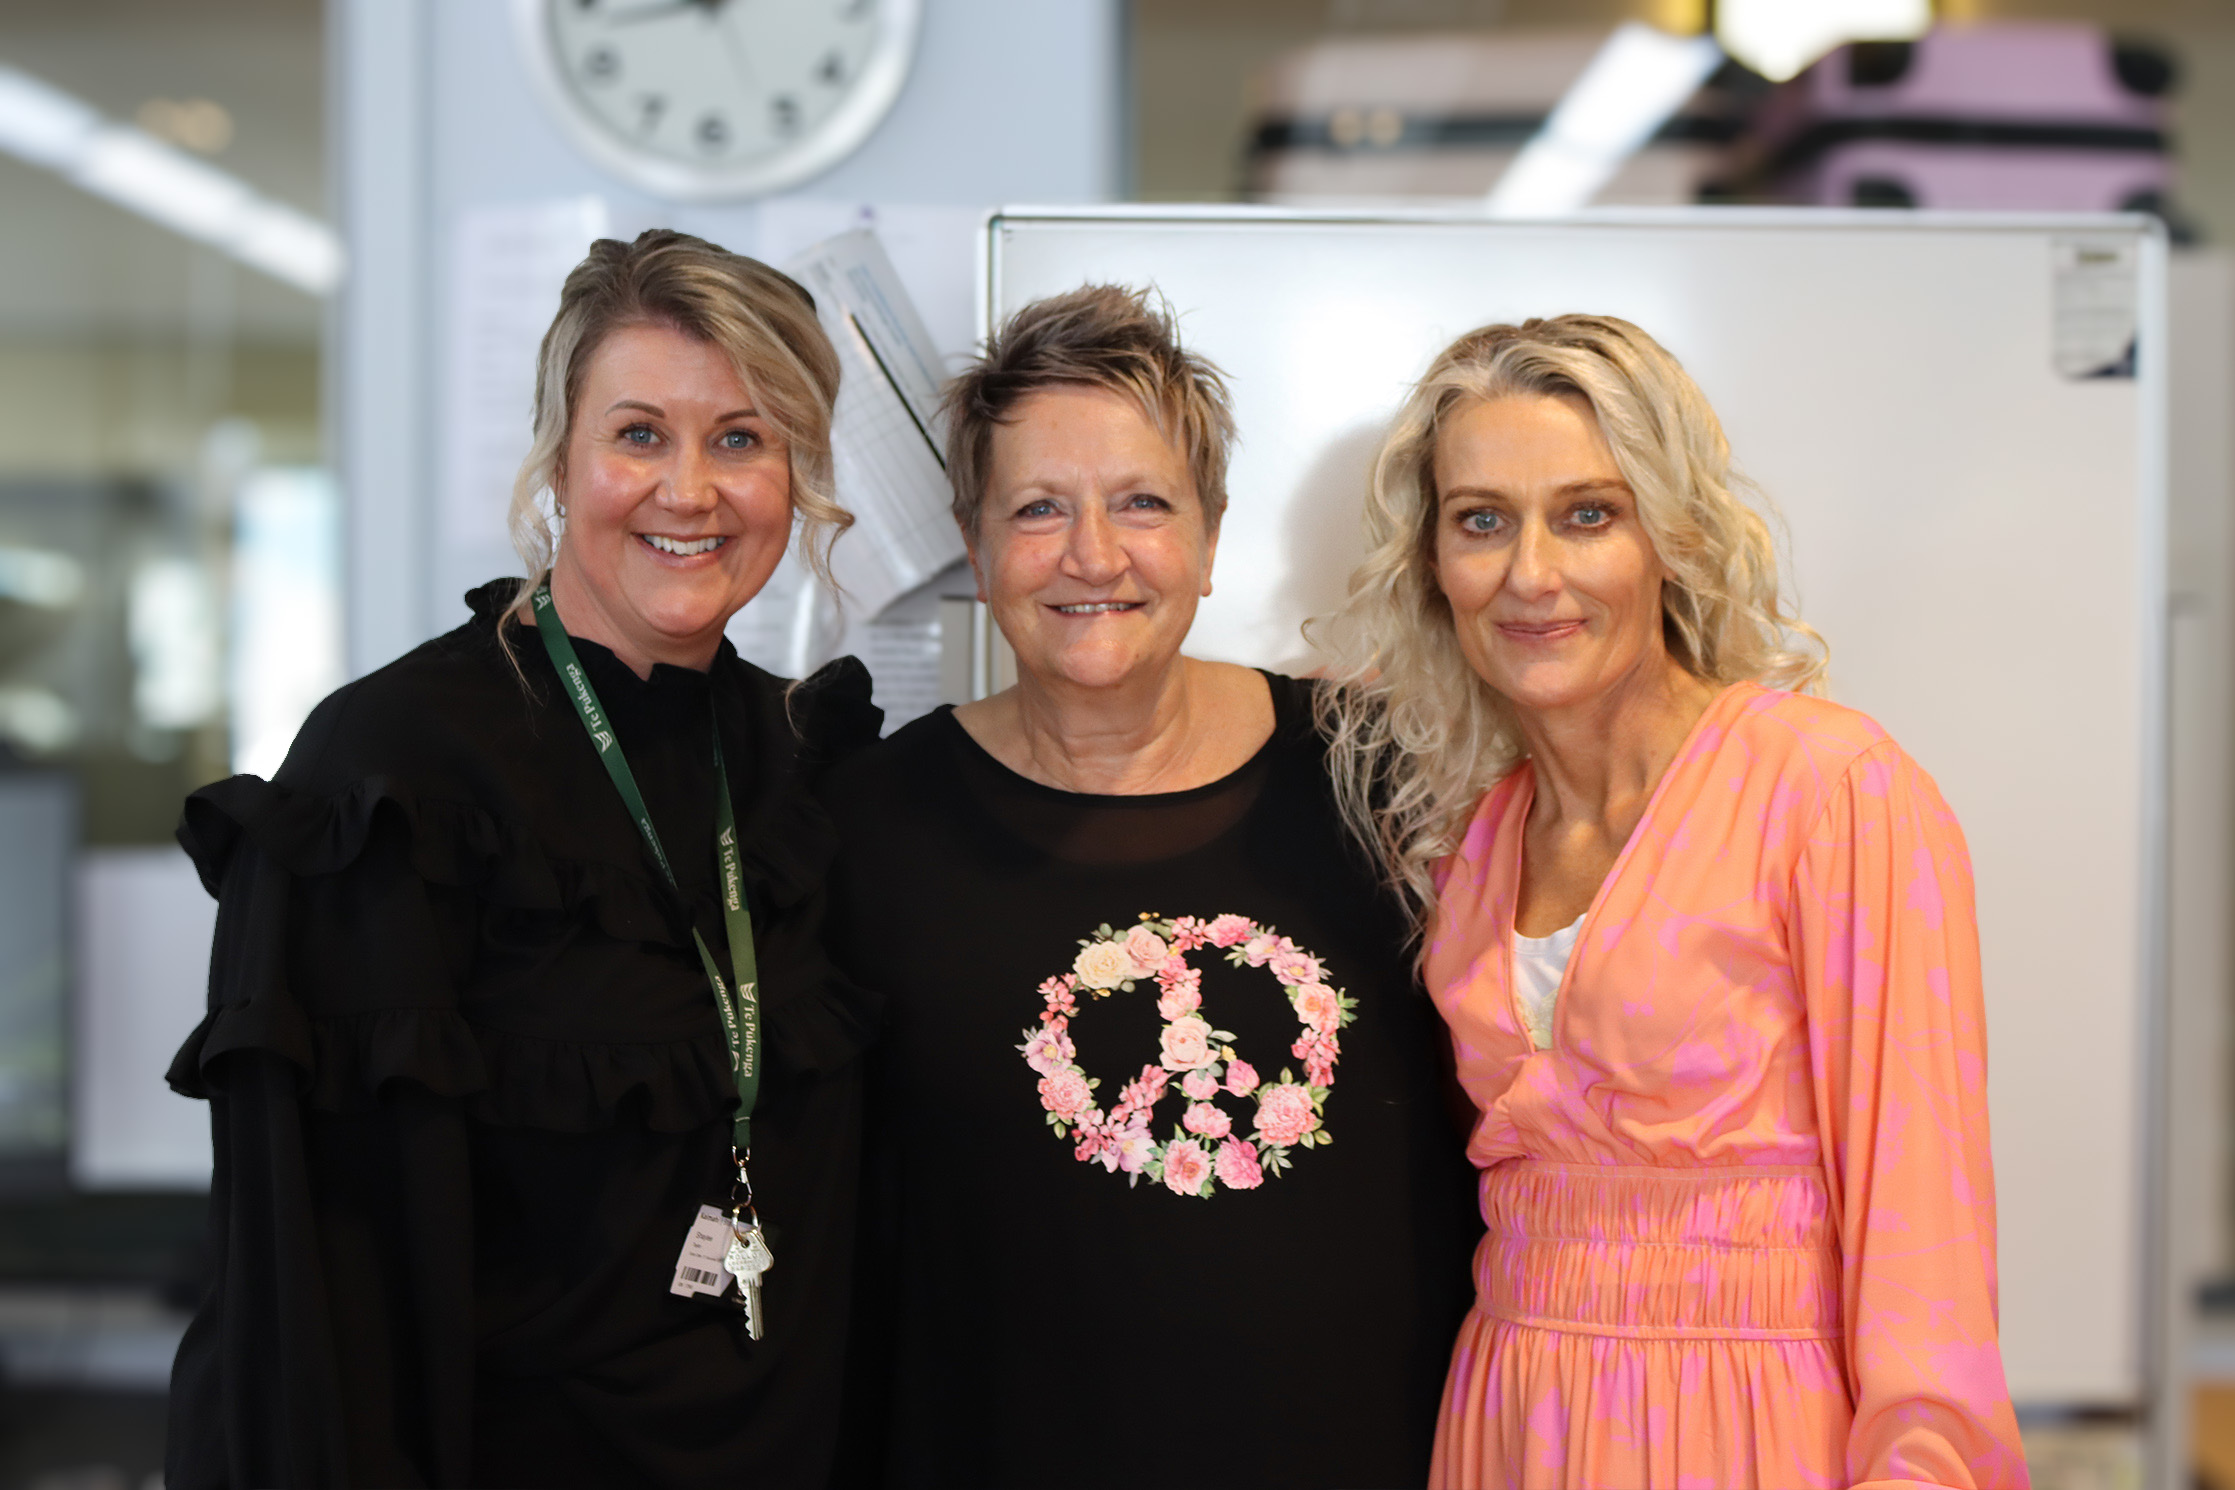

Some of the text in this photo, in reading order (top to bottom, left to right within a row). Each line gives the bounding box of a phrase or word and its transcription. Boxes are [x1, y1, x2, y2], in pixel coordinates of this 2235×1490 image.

[590, 713, 602, 731] Te
[723, 846, 735, 863] Te
[744, 1004, 755, 1020] Te
